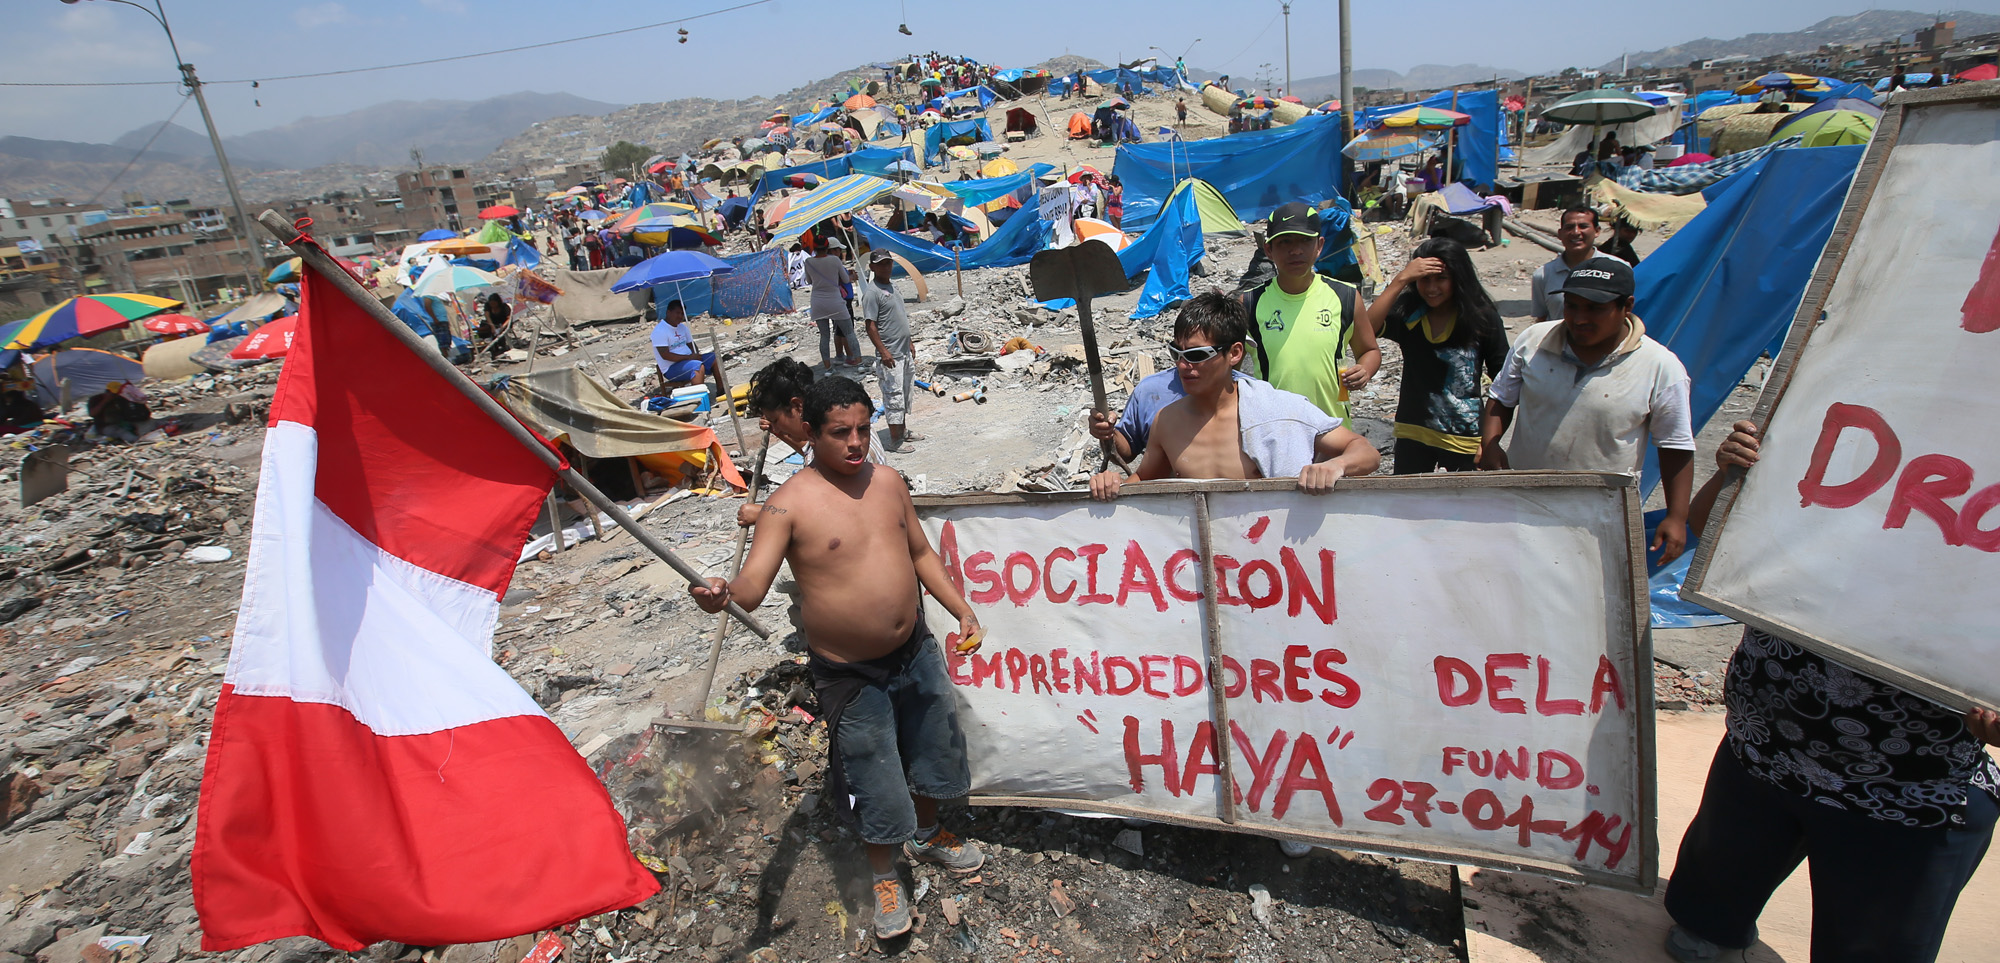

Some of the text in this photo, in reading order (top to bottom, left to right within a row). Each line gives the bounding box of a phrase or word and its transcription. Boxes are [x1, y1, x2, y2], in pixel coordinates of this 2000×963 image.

[924, 516, 1338, 625] ASOCIACIÓN
[945, 631, 1362, 709] EMPRENDEDORES
[1441, 745, 1600, 796] FUND.
[1364, 778, 1632, 869] 27-01-14
